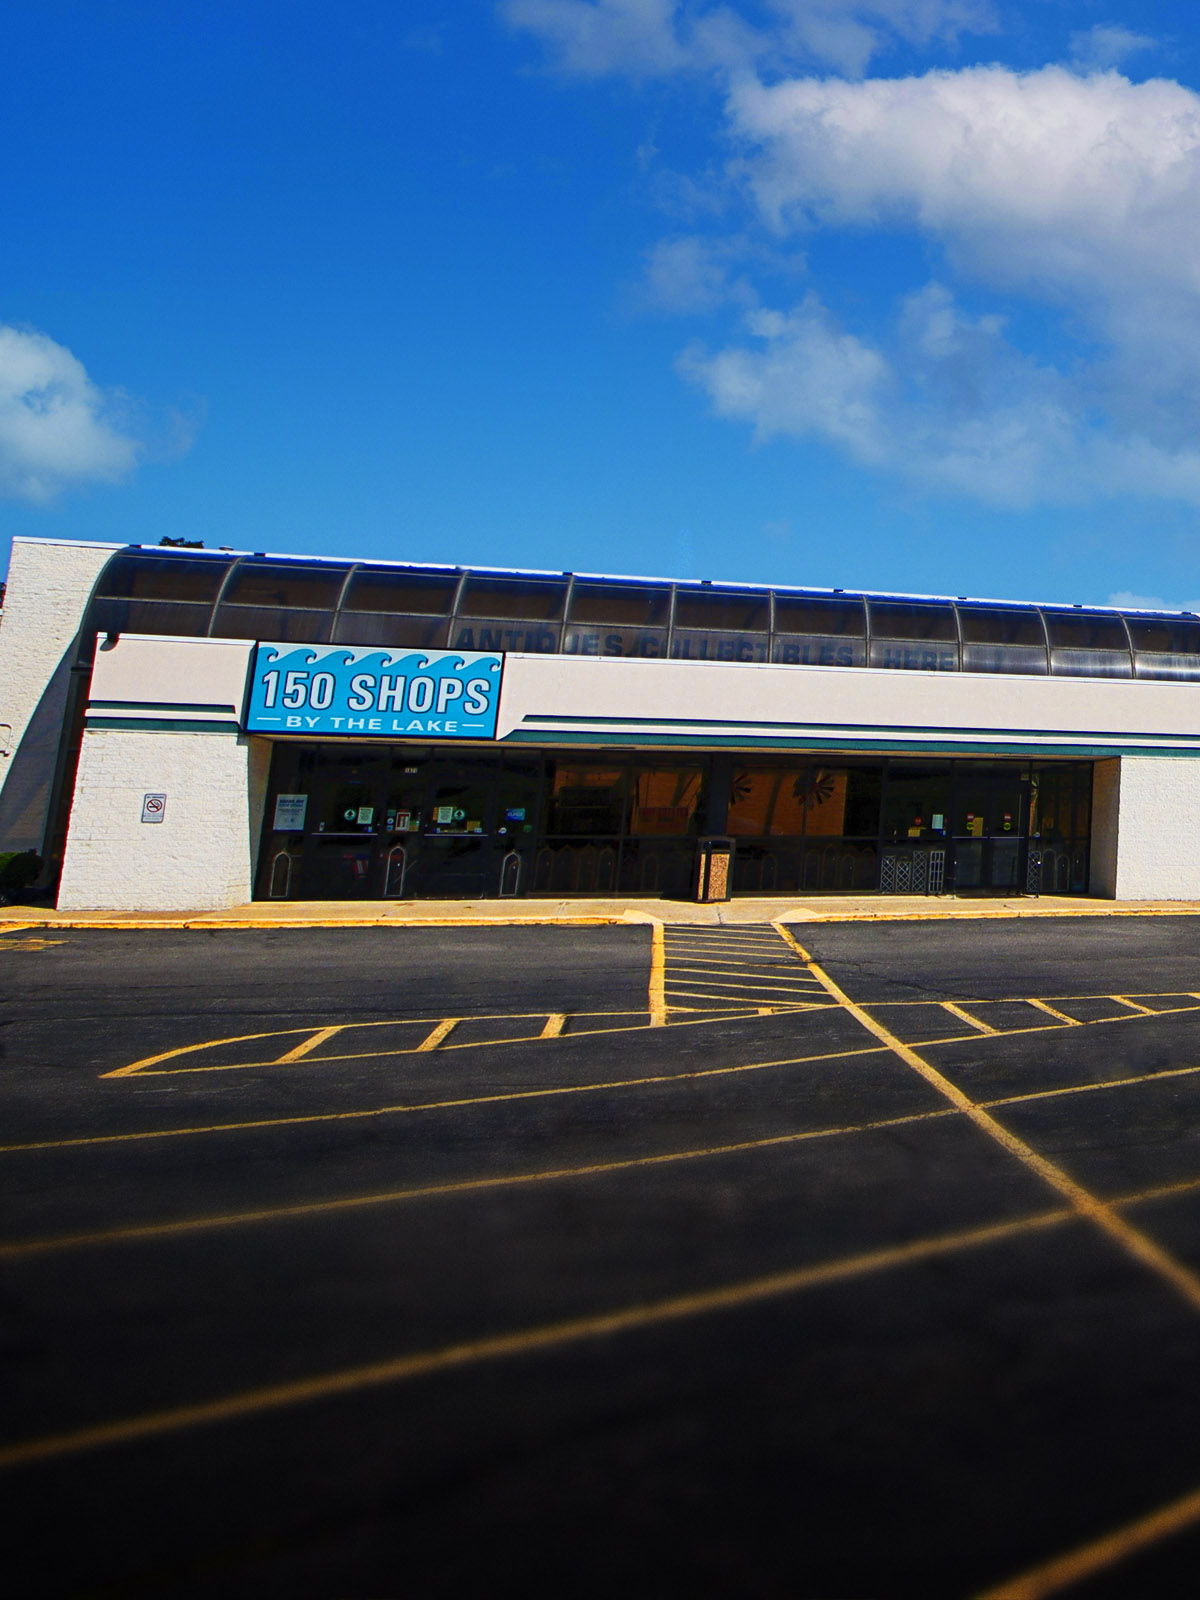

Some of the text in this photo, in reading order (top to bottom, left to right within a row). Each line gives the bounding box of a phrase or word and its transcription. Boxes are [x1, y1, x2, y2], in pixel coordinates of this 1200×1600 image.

[883, 649, 954, 671] HERE
[262, 670, 491, 715] 150 SHOPS
[286, 715, 458, 732] BY THE LAKE
